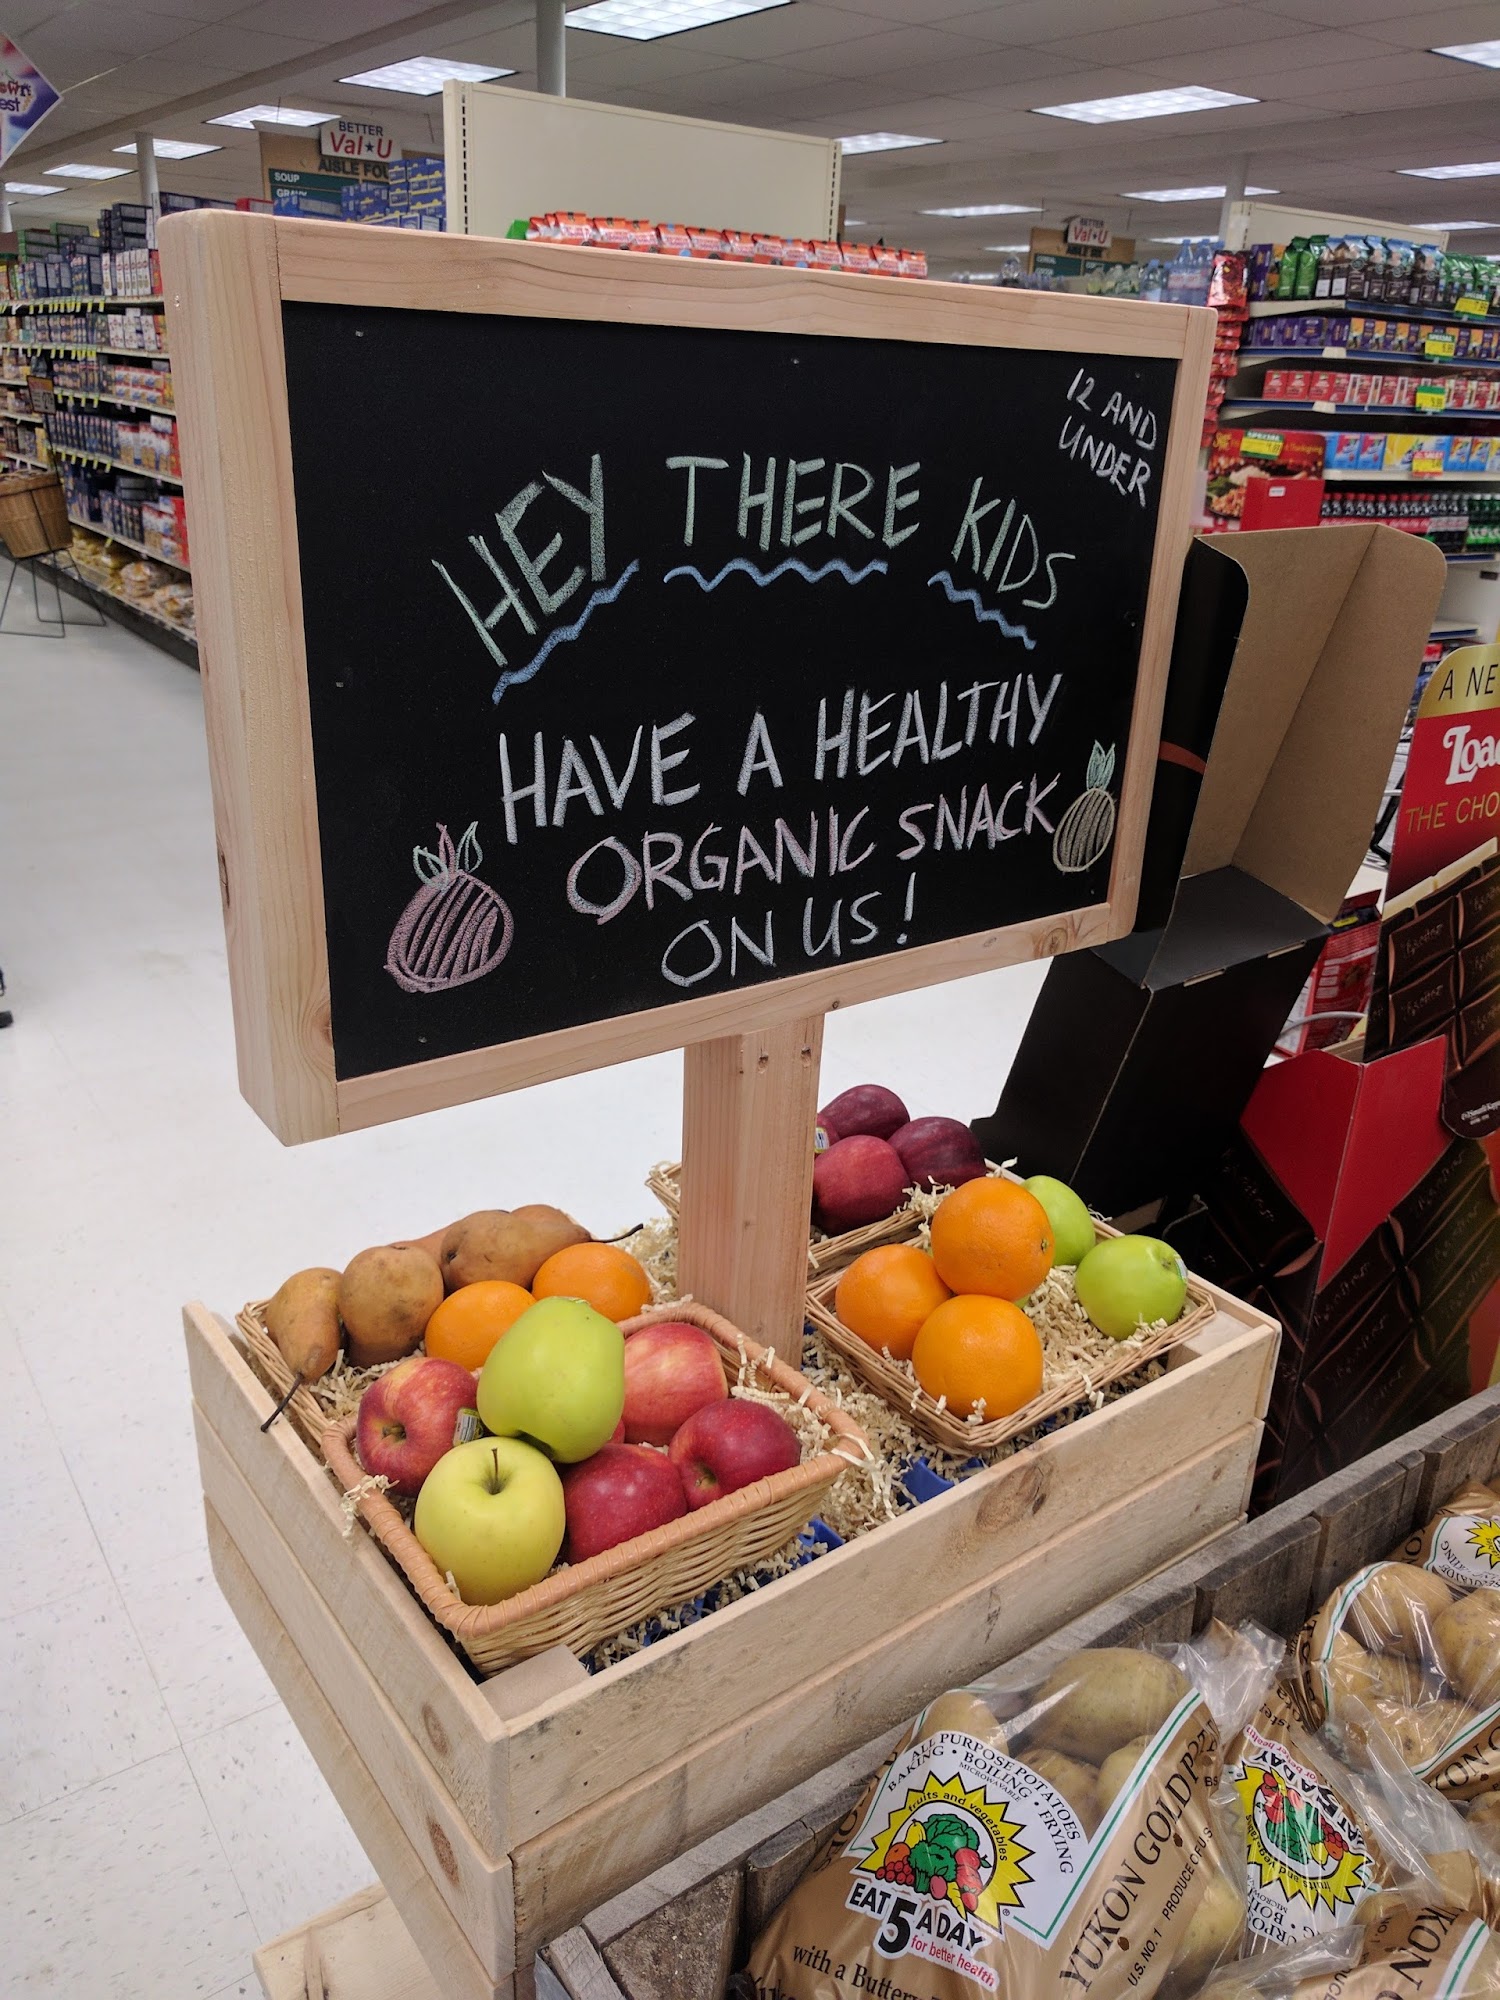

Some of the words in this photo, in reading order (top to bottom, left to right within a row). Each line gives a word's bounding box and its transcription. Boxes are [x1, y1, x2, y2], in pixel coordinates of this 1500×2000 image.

[339, 120, 384, 137] BETTER
[274, 171, 300, 184] SOUP
[318, 158, 360, 176] AISLE
[1066, 367, 1096, 412] 12
[1101, 390, 1158, 450] AND
[1058, 414, 1152, 508] UNDER
[431, 453, 606, 668] HEY
[666, 451, 921, 551] THERE
[950, 476, 1076, 610] KIDS
[1438, 669, 1454, 701] A
[500, 711, 701, 845] HAVE
[736, 708, 785, 797] A
[813, 671, 1064, 782] HEALTHY
[567, 804, 878, 926] ORGANIC
[896, 772, 1061, 861] SNACK
[1405, 800, 1449, 834] THE
[661, 909, 777, 988] ON
[911, 1738, 936, 1761] ALL
[939, 1733, 1016, 1772] PURPOSE
[1014, 1766, 1081, 1841] POTATOES
[959, 1761, 1023, 1803] MICROWAVABLE
[1253, 1749, 1297, 1782] DAY
[1301, 1778, 1318, 1794] A
[887, 1745, 944, 1793] BAKING
[963, 1750, 1033, 1799] BOILING
[1038, 1809, 1075, 1875] FRYING
[908, 1791, 939, 1812] fruits
[943, 1792, 967, 1806] and
[969, 1802, 1009, 1862] vegetables
[849, 1882, 892, 1915] EAT
[877, 1896, 918, 1954] 5
[915, 1908, 932, 1935] A
[936, 1912, 985, 1953] DAY
[1059, 1858, 1147, 1993] YUKON
[1133, 1772, 1192, 1867] GOLD
[910, 1934, 929, 1953] for
[928, 1941, 956, 1965] better
[956, 1953, 996, 1988] health
[1126, 1959, 1147, 1987] U.S.
[1161, 1865, 1196, 1922] PRODUCE
[793, 1945, 832, 1976] with
[834, 1964, 845, 1981] a
